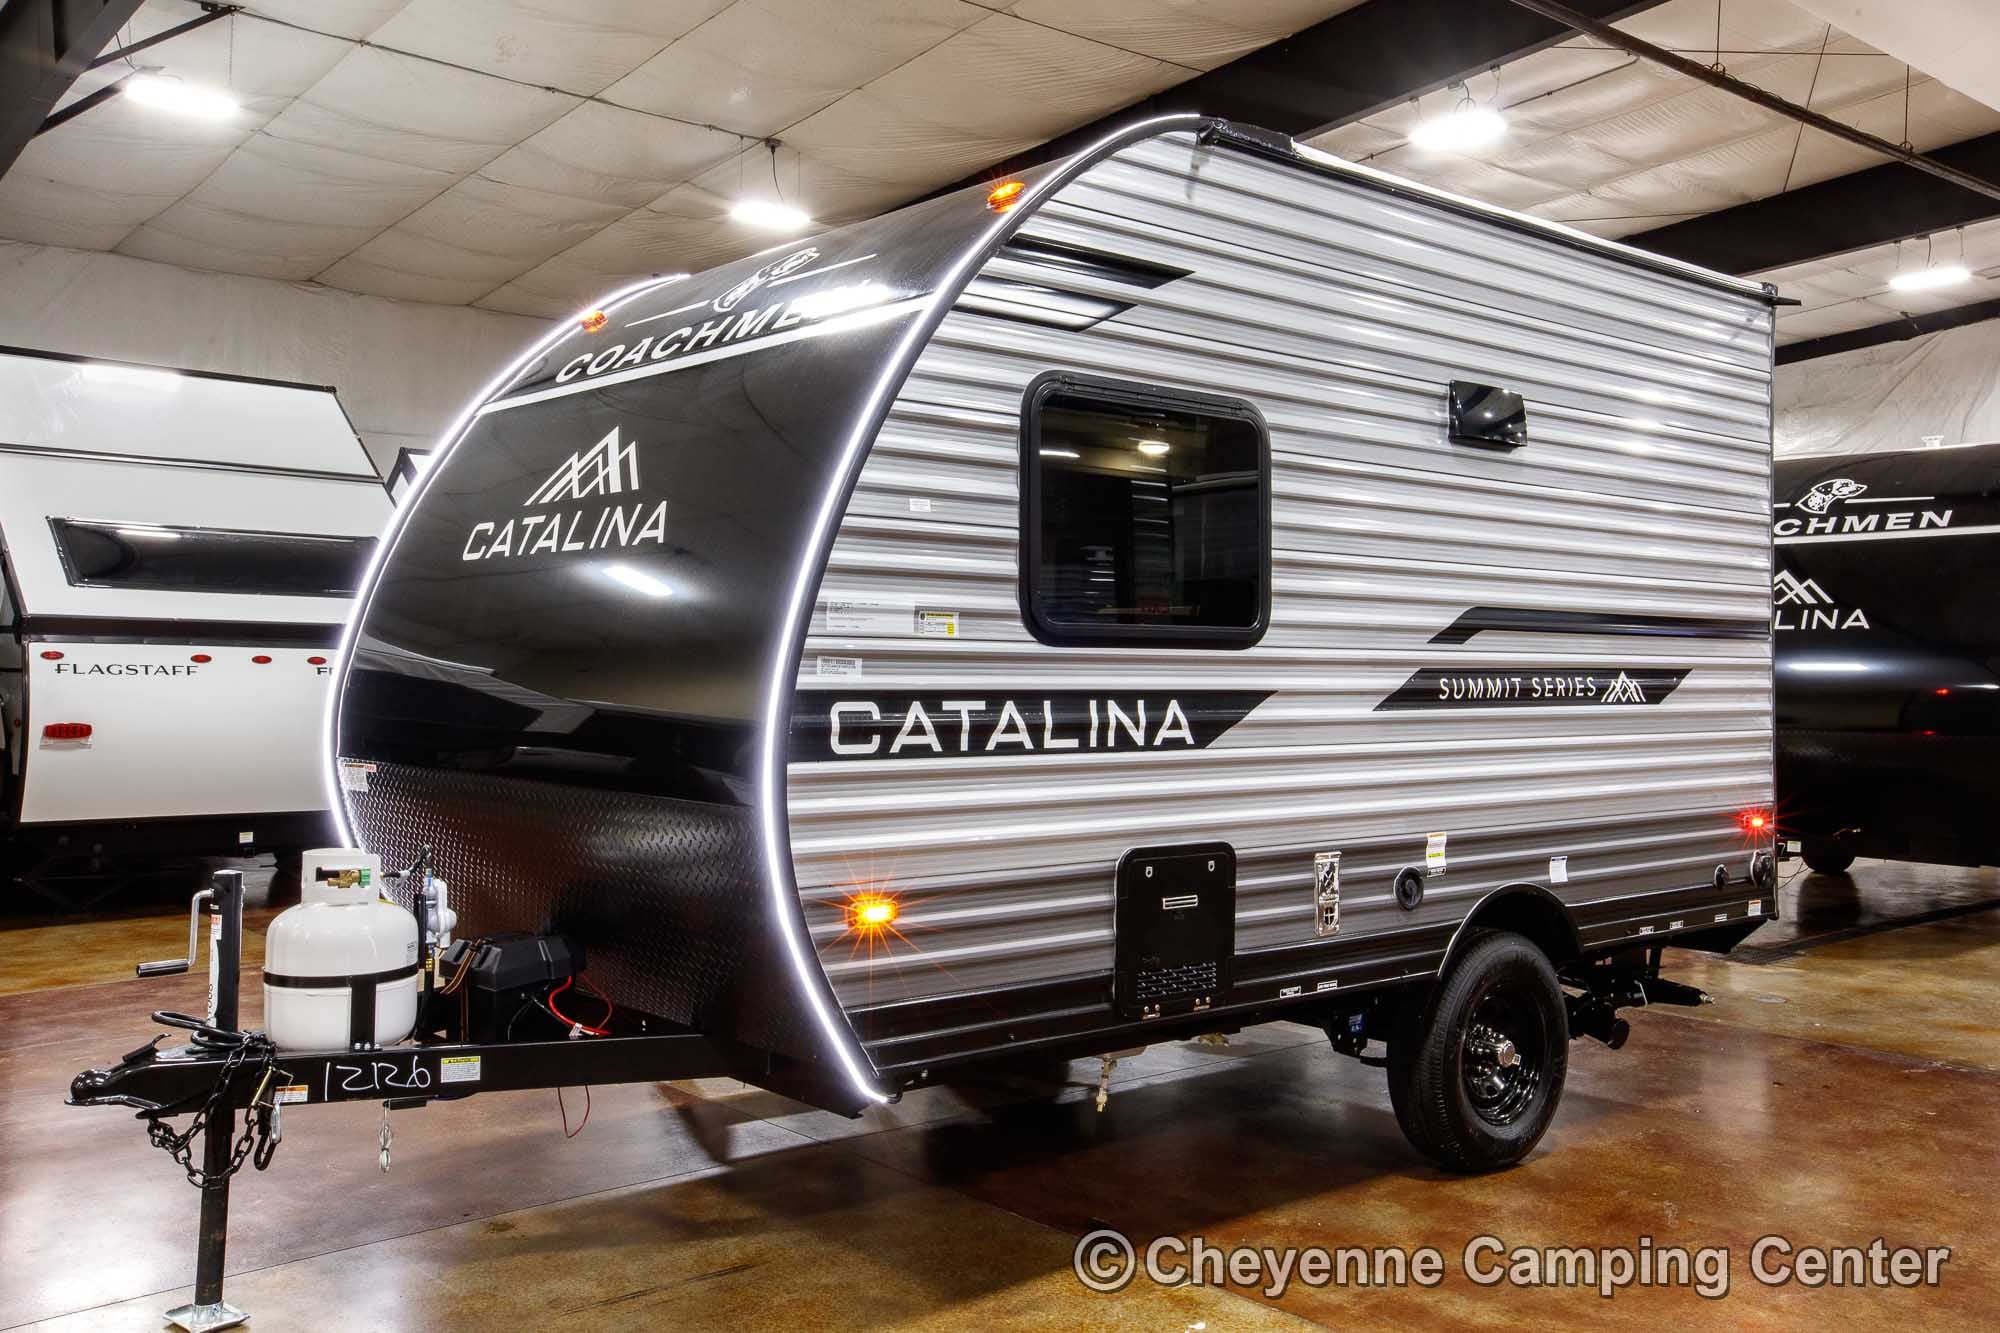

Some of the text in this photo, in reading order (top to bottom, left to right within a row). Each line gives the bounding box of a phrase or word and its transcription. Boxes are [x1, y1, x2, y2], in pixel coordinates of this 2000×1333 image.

[555, 279, 868, 384] COACHME
[462, 501, 668, 561] CATALINA
[1774, 510, 1953, 536] CHMEN
[1774, 608, 1871, 630] LINA
[54, 663, 199, 676] FLAGSTAFF
[1439, 676, 1597, 700] SUMMIT SERIES
[829, 699, 1195, 755] CATALINA
